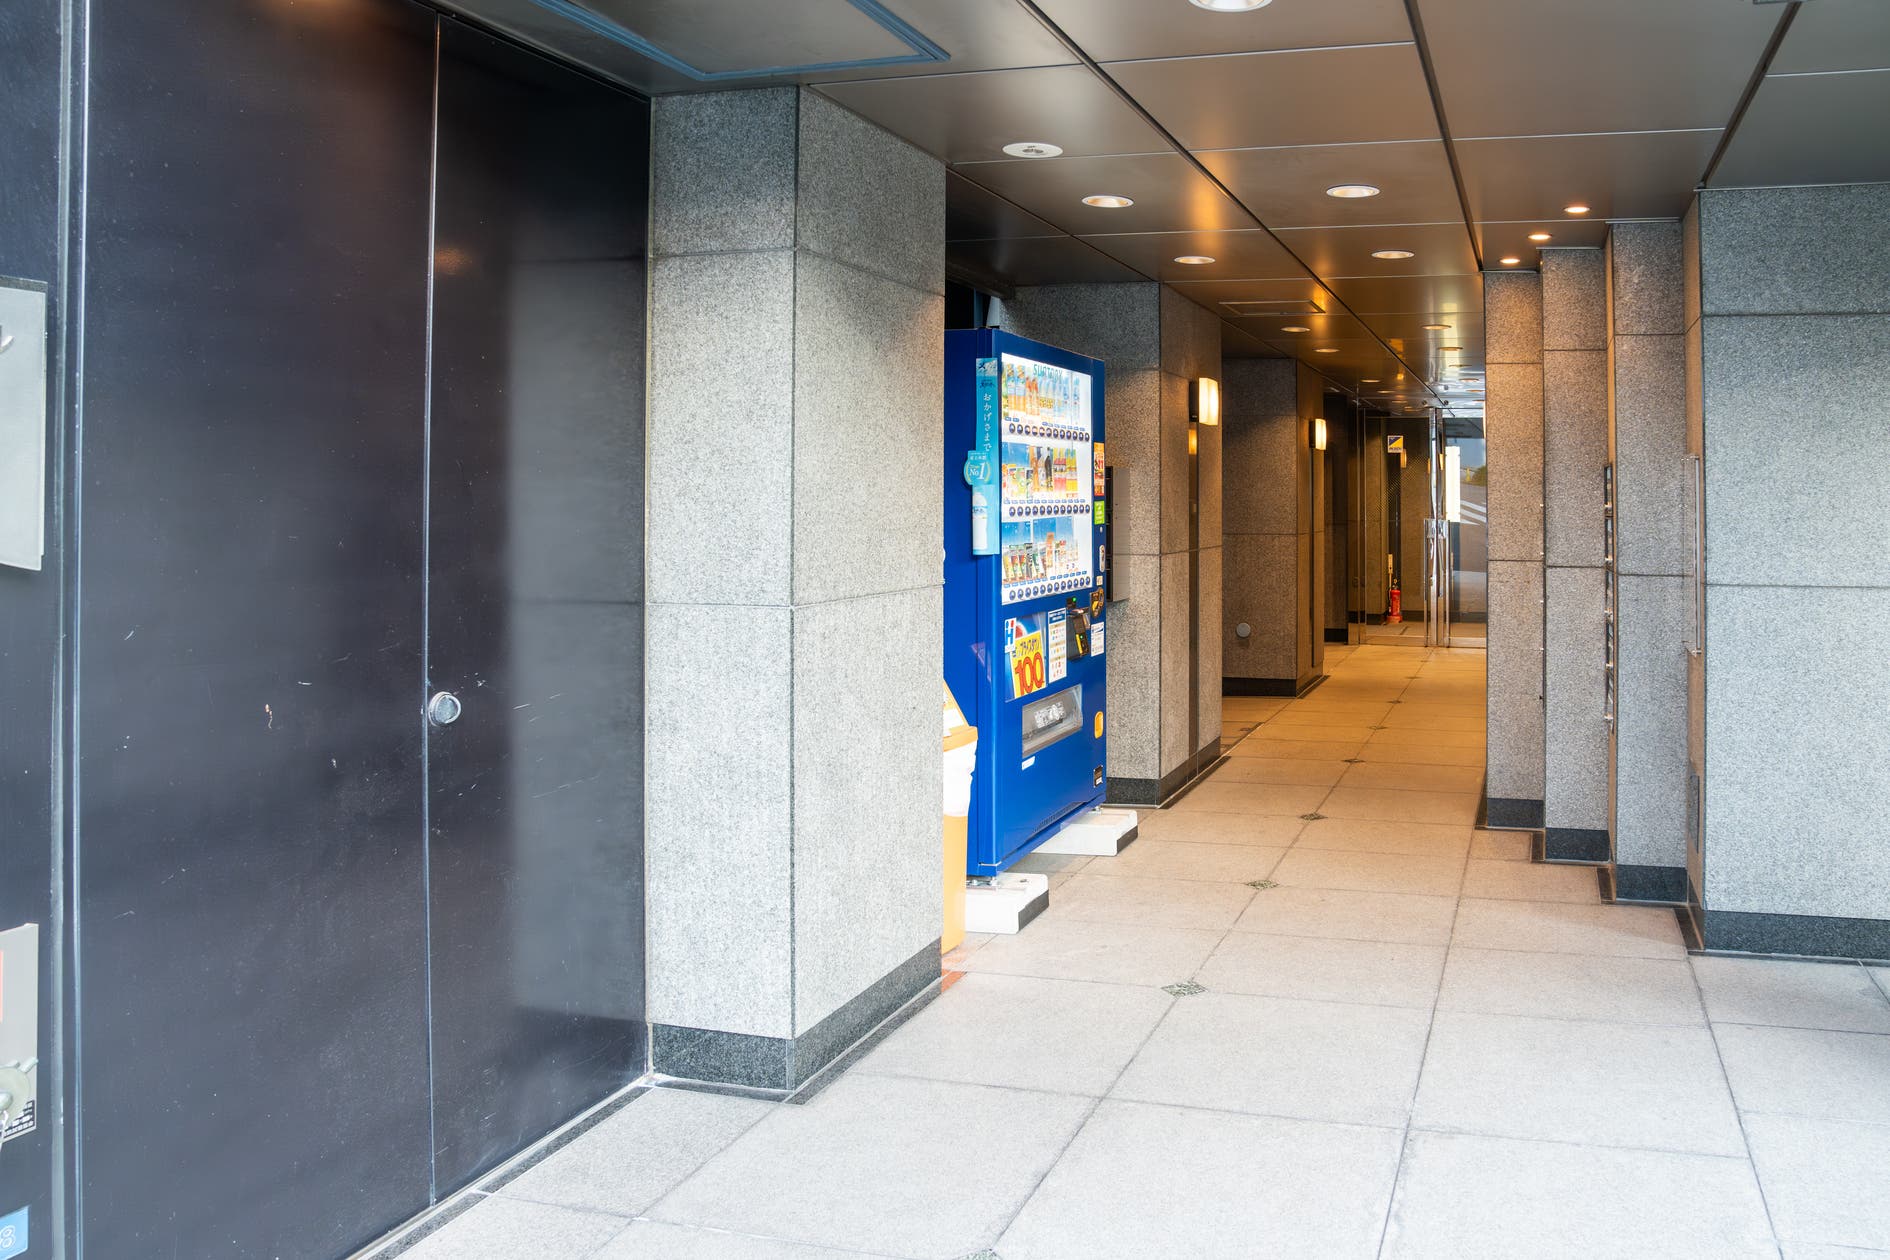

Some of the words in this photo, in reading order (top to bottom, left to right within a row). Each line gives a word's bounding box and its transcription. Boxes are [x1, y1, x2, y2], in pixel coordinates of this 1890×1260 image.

[983, 393, 992, 452] おかげさまで
[1015, 652, 1045, 696] 100
